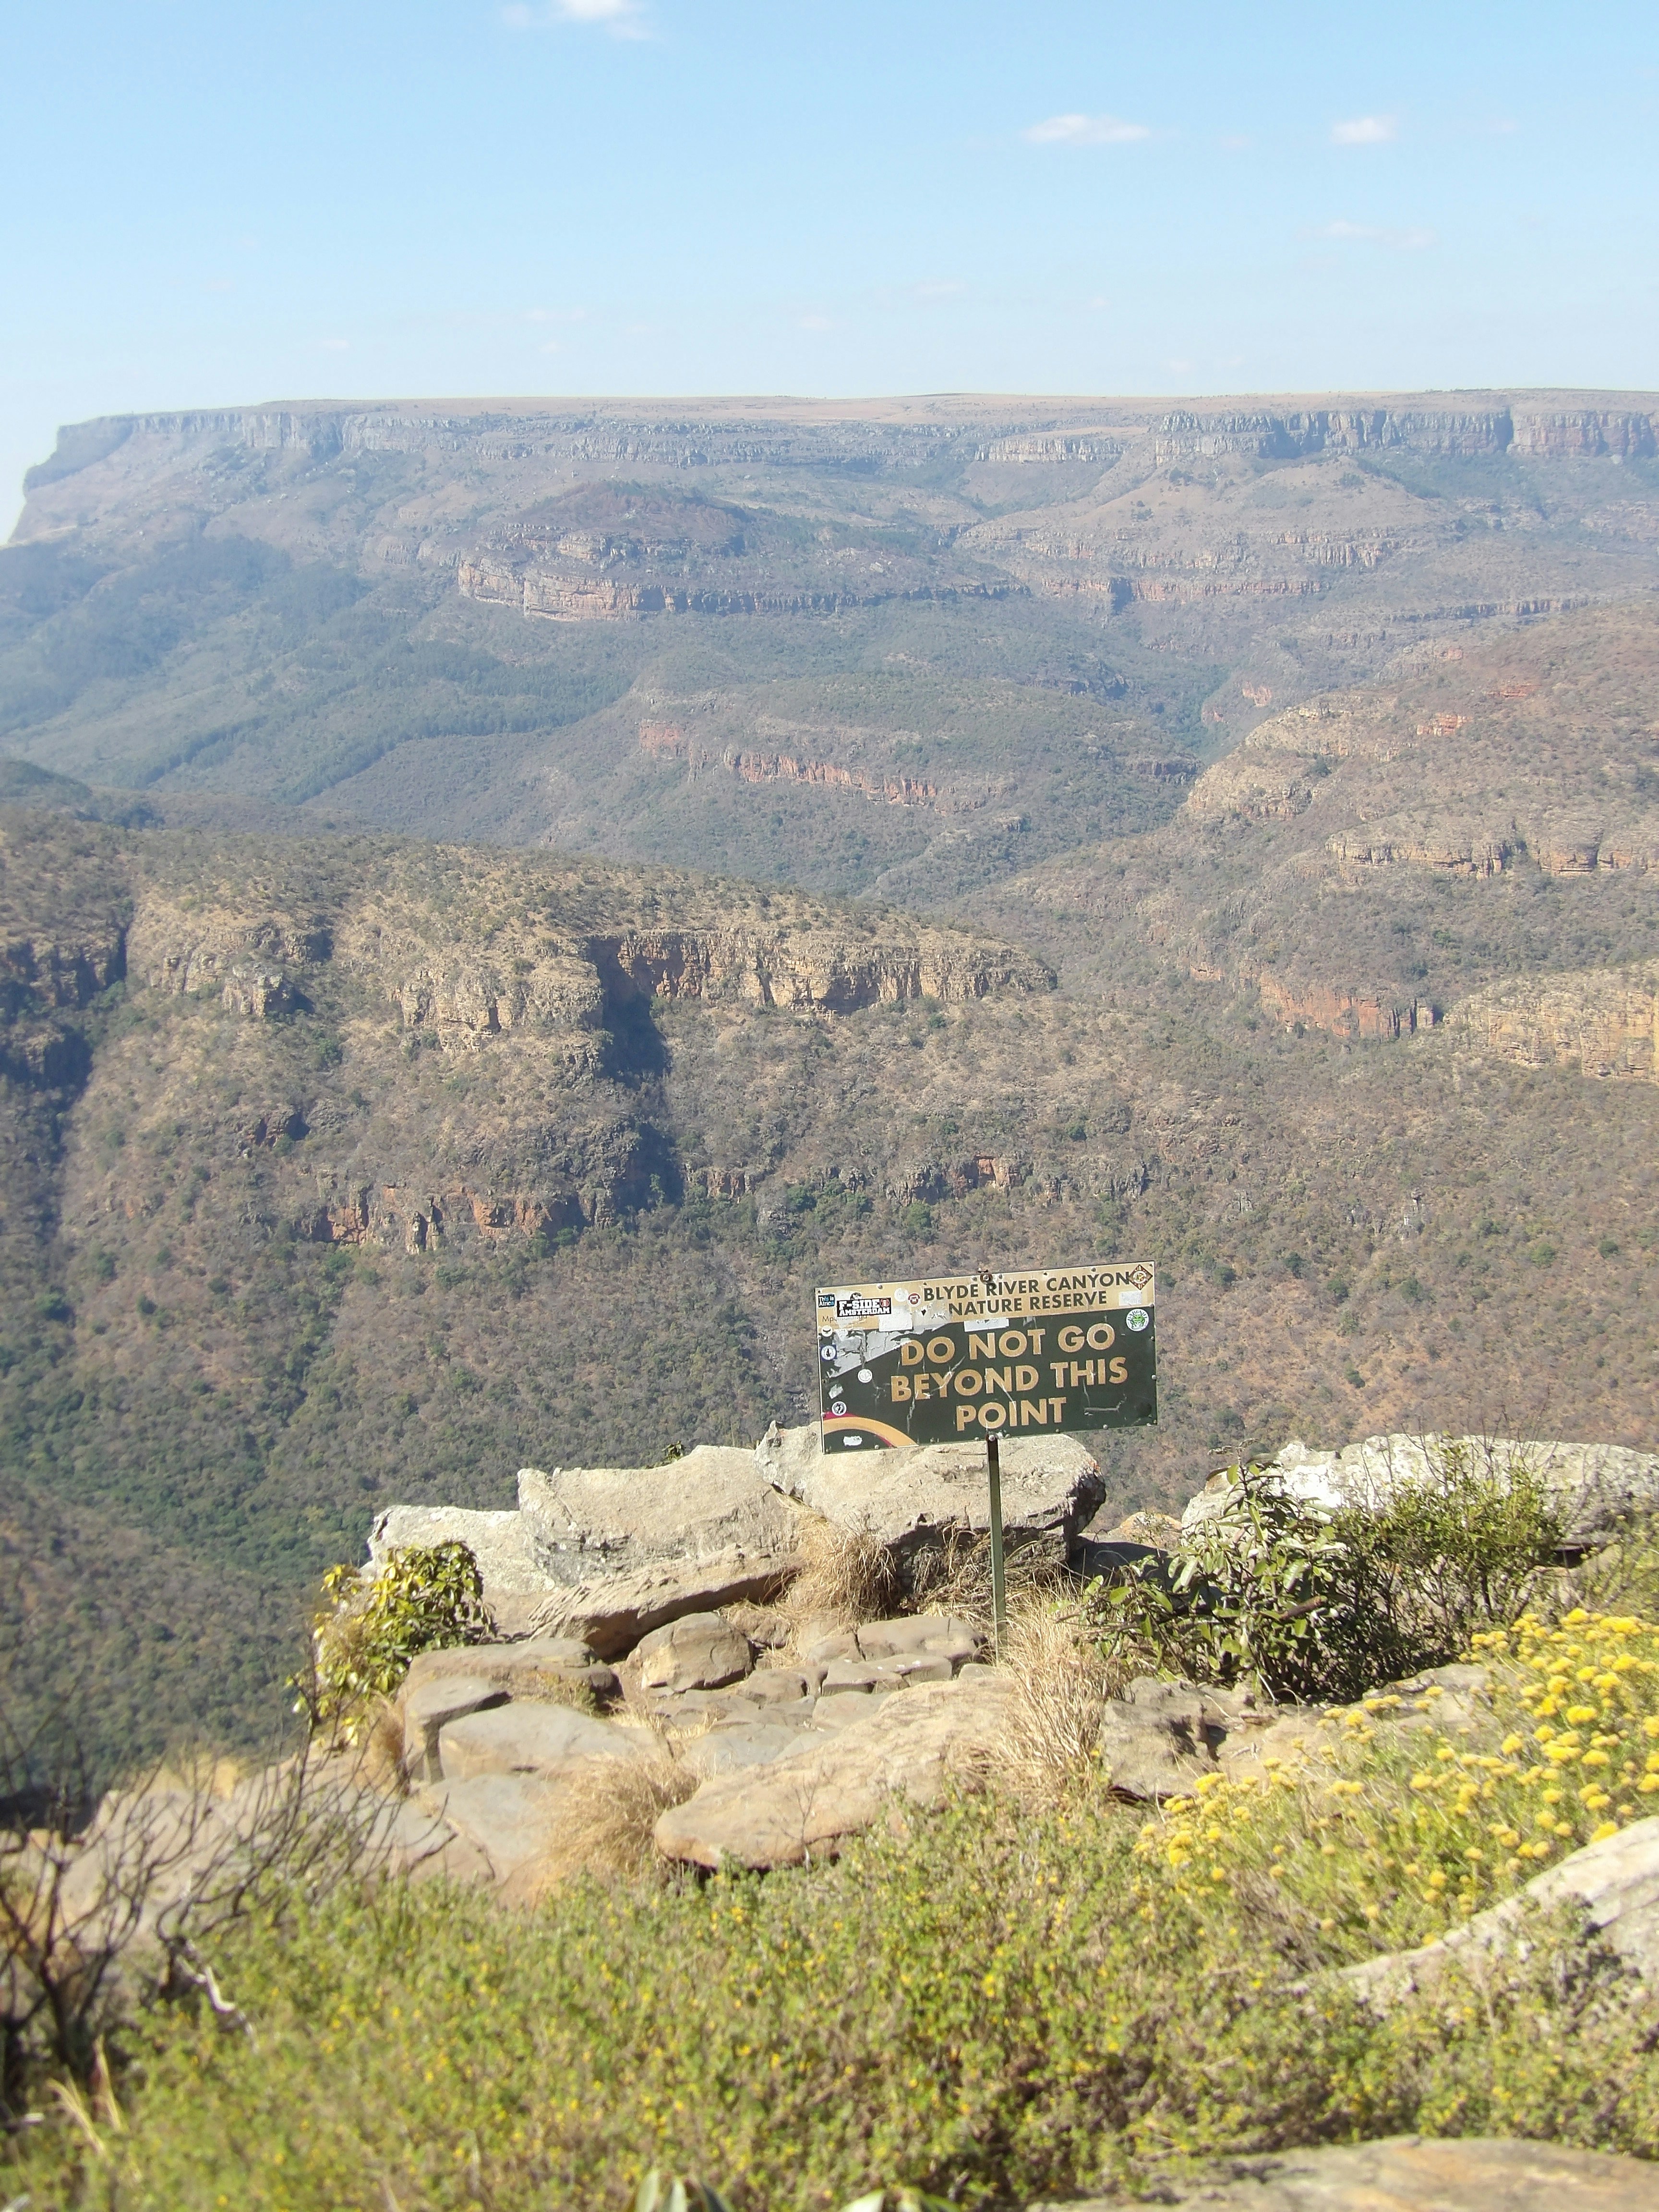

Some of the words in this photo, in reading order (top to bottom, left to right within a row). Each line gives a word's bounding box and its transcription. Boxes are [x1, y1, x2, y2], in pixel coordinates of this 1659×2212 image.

[924, 1284, 978, 1301] BLYDE
[986, 1280, 1040, 1296] RIVER
[1046, 1272, 1130, 1291] CANYON
[839, 1299, 880, 1310] F-SIDE
[839, 1307, 890, 1316] AMSTERDAM
[949, 1298, 1022, 1315] NATURE
[1030, 1290, 1107, 1310] RESERVE
[901, 1336, 955, 1366] DO
[969, 1328, 1046, 1360] NOT
[1058, 1322, 1116, 1353] GO
[890, 1364, 1039, 1402] BEYOND
[1050, 1356, 1128, 1388] THIS
[956, 1396, 1067, 1431] POINT
